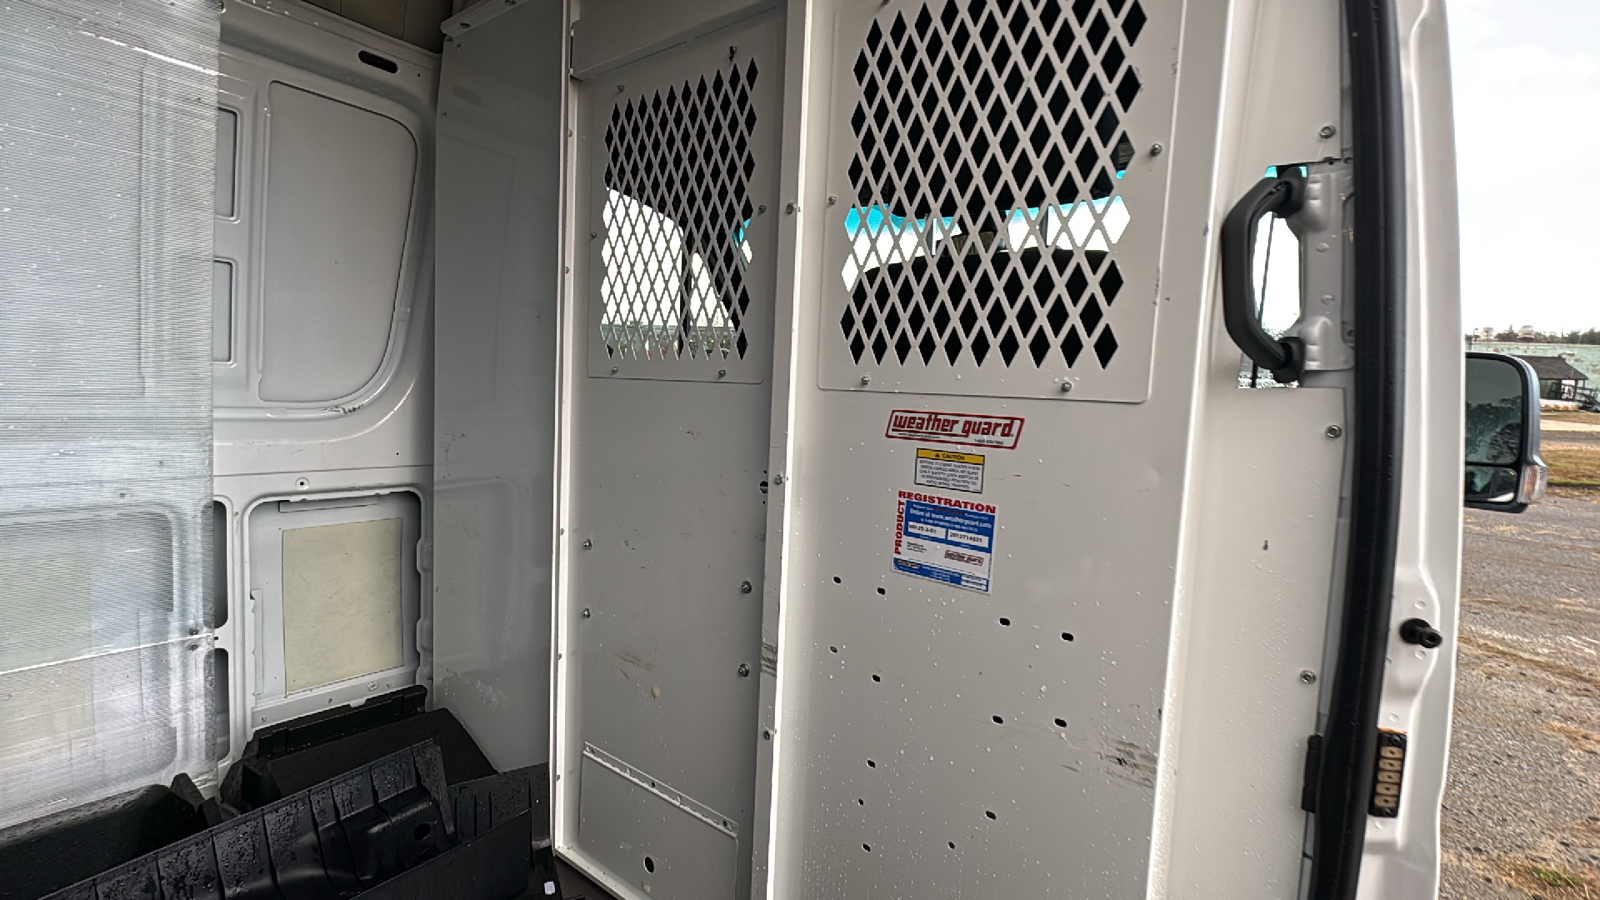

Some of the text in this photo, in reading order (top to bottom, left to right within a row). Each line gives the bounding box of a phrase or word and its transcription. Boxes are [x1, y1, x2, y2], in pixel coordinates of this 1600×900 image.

[893, 414, 1014, 438] weather guard
[898, 491, 996, 514] REGISTRATION
[894, 500, 905, 555] PRODUCT
